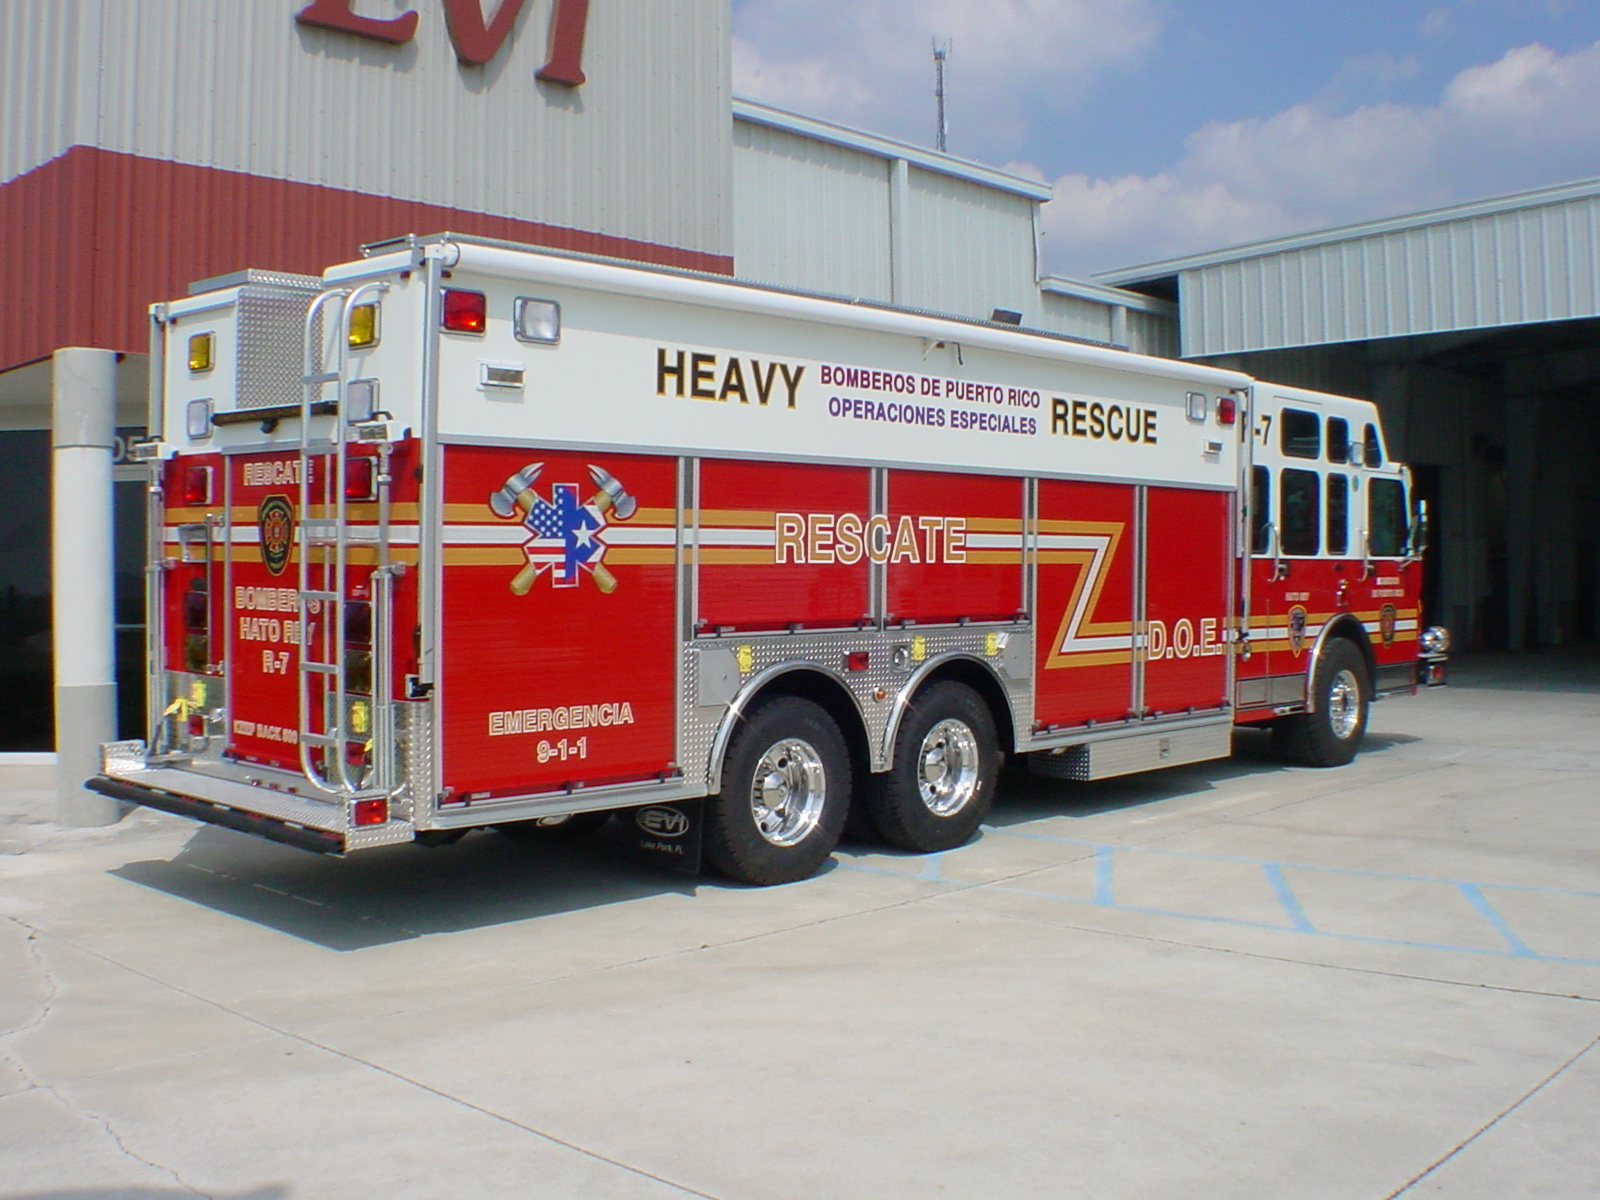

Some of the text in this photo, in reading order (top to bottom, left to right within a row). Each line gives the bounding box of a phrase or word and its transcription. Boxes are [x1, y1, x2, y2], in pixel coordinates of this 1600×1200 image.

[656, 347, 806, 410] HEAVY
[820, 364, 1041, 409] BOMBEROS DE PUERTO RICO
[828, 396, 1037, 436] OPERACIONES ESPECIALES
[1050, 397, 1158, 446] RESCUE
[775, 512, 967, 565] RESCATE
[235, 586, 321, 614] BOMBERS
[239, 616, 281, 643] HATO
[1147, 617, 1223, 661] D.O.E.
[262, 649, 290, 675] R-7
[489, 702, 634, 736] EMERGENCIA
[536, 736, 588, 764] 9-1-1
